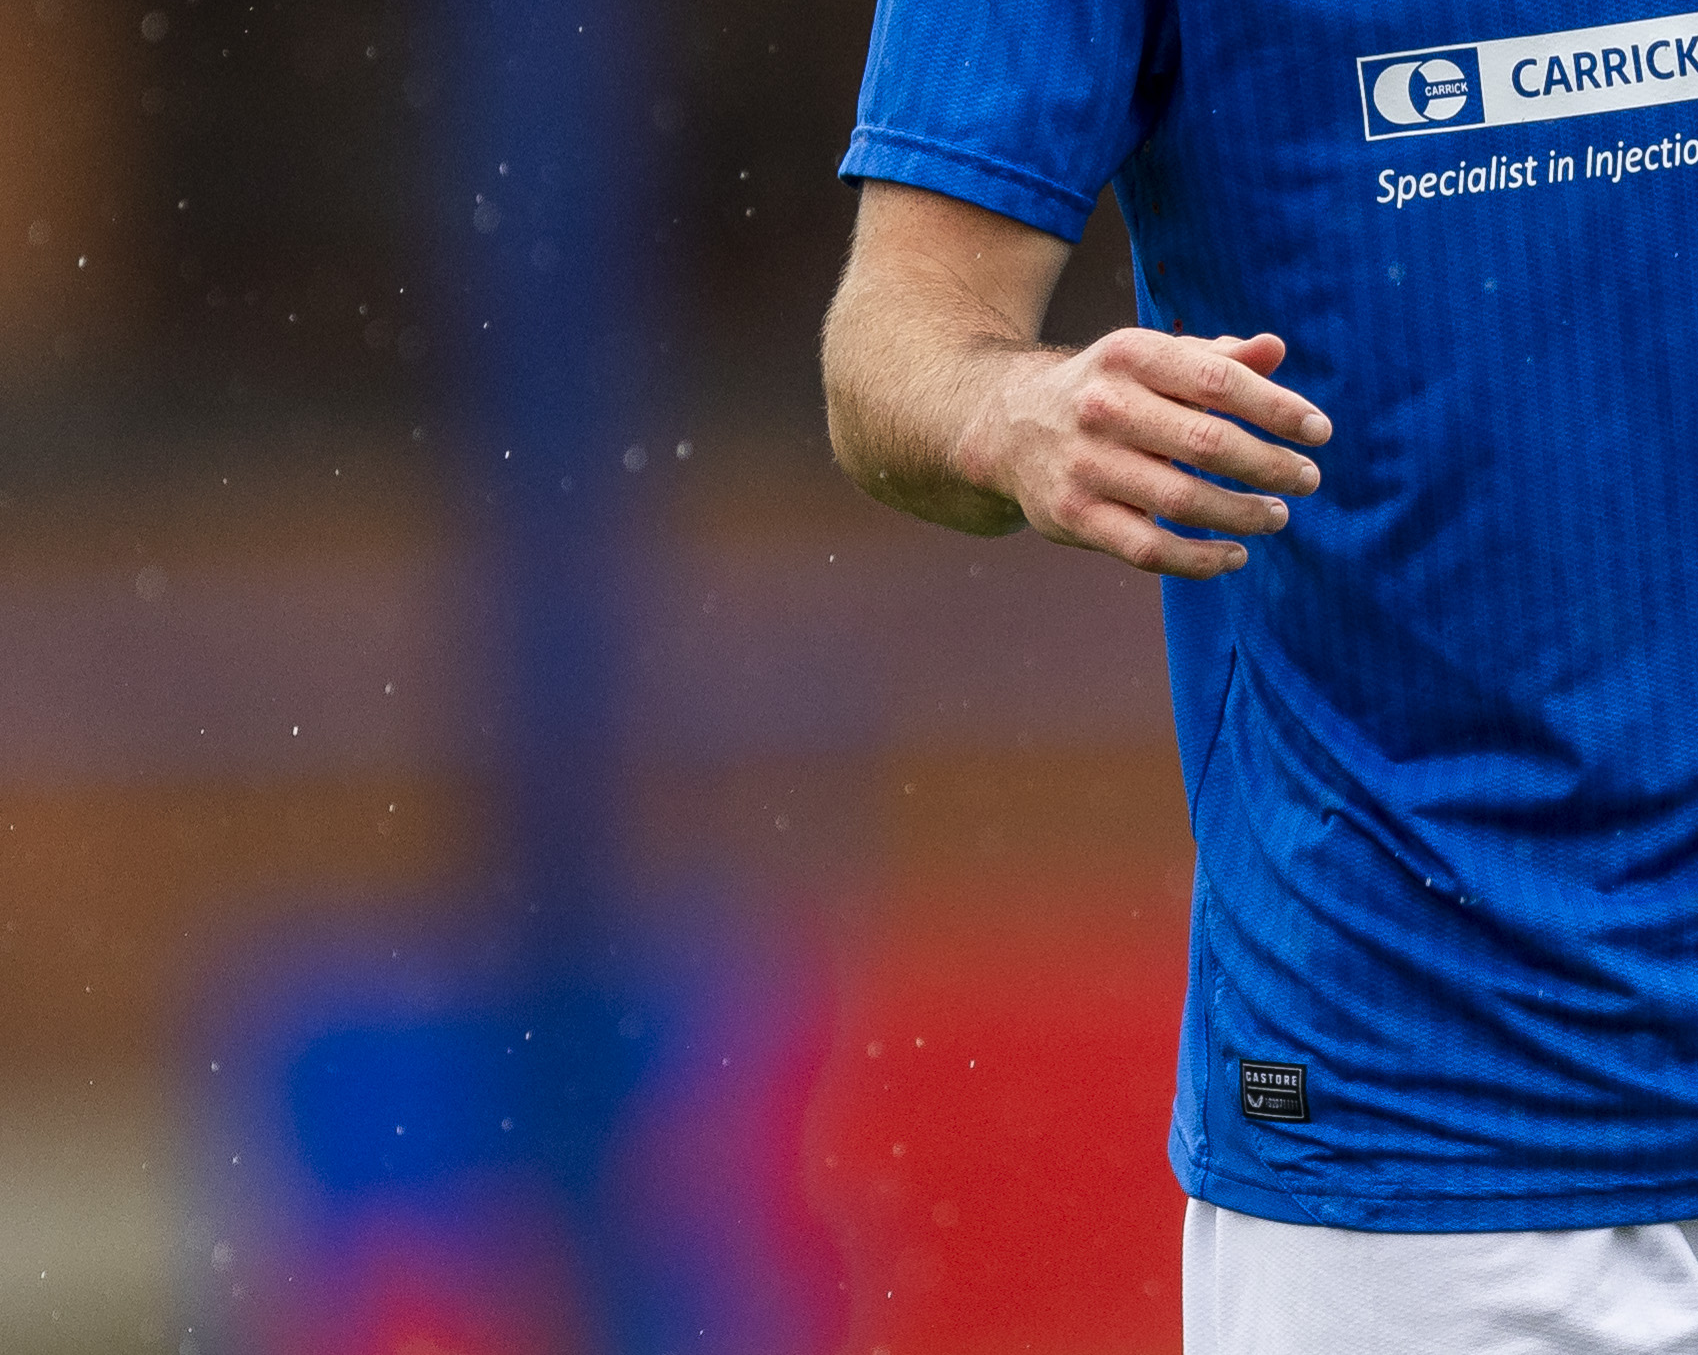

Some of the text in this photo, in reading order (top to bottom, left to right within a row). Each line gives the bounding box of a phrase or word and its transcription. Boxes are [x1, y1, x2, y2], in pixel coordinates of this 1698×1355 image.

[1424, 82, 1469, 97] CARRICK
[1376, 155, 1538, 209] Specialist
[1548, 149, 1574, 183] in
[1245, 1071, 1297, 1086] CASTORE
